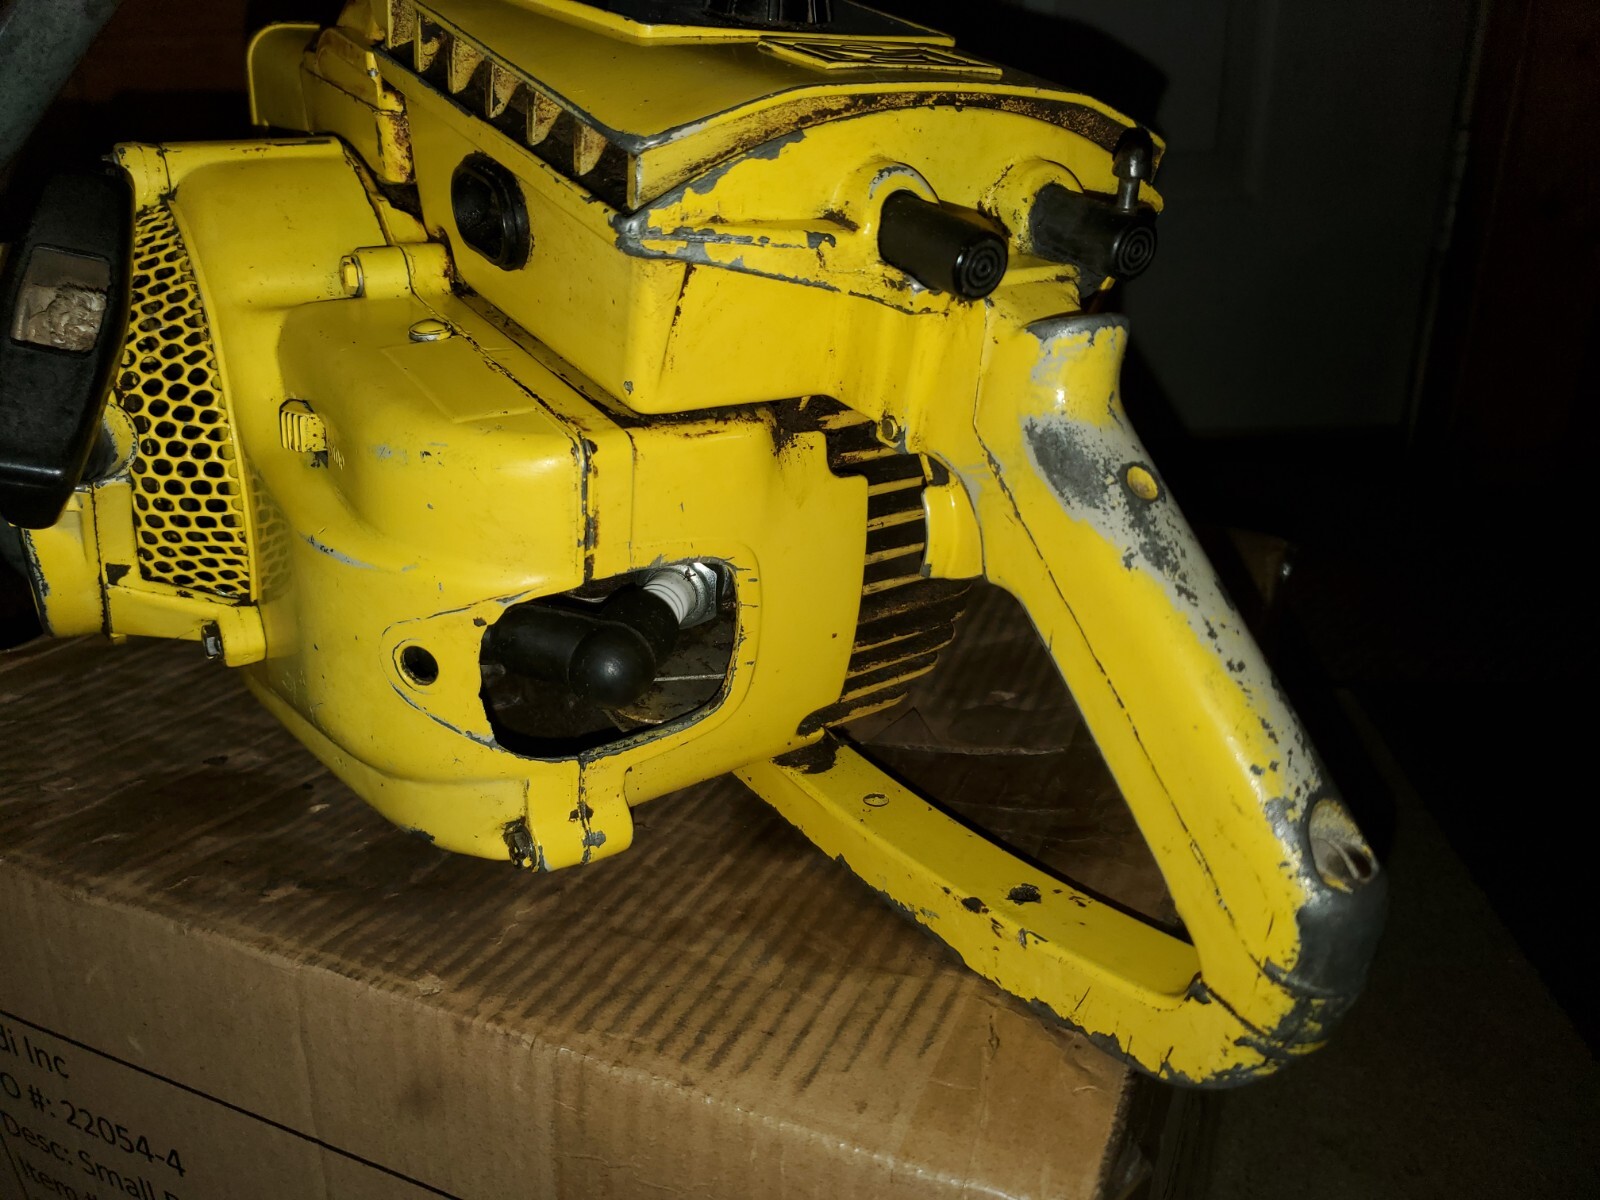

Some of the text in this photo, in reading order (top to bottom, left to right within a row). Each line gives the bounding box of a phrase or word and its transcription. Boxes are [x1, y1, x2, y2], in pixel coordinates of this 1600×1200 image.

[24, 1036, 69, 1079] Inc
[0, 1110, 156, 1200] Desc: Small
[60, 1100, 187, 1178] 22054-4
